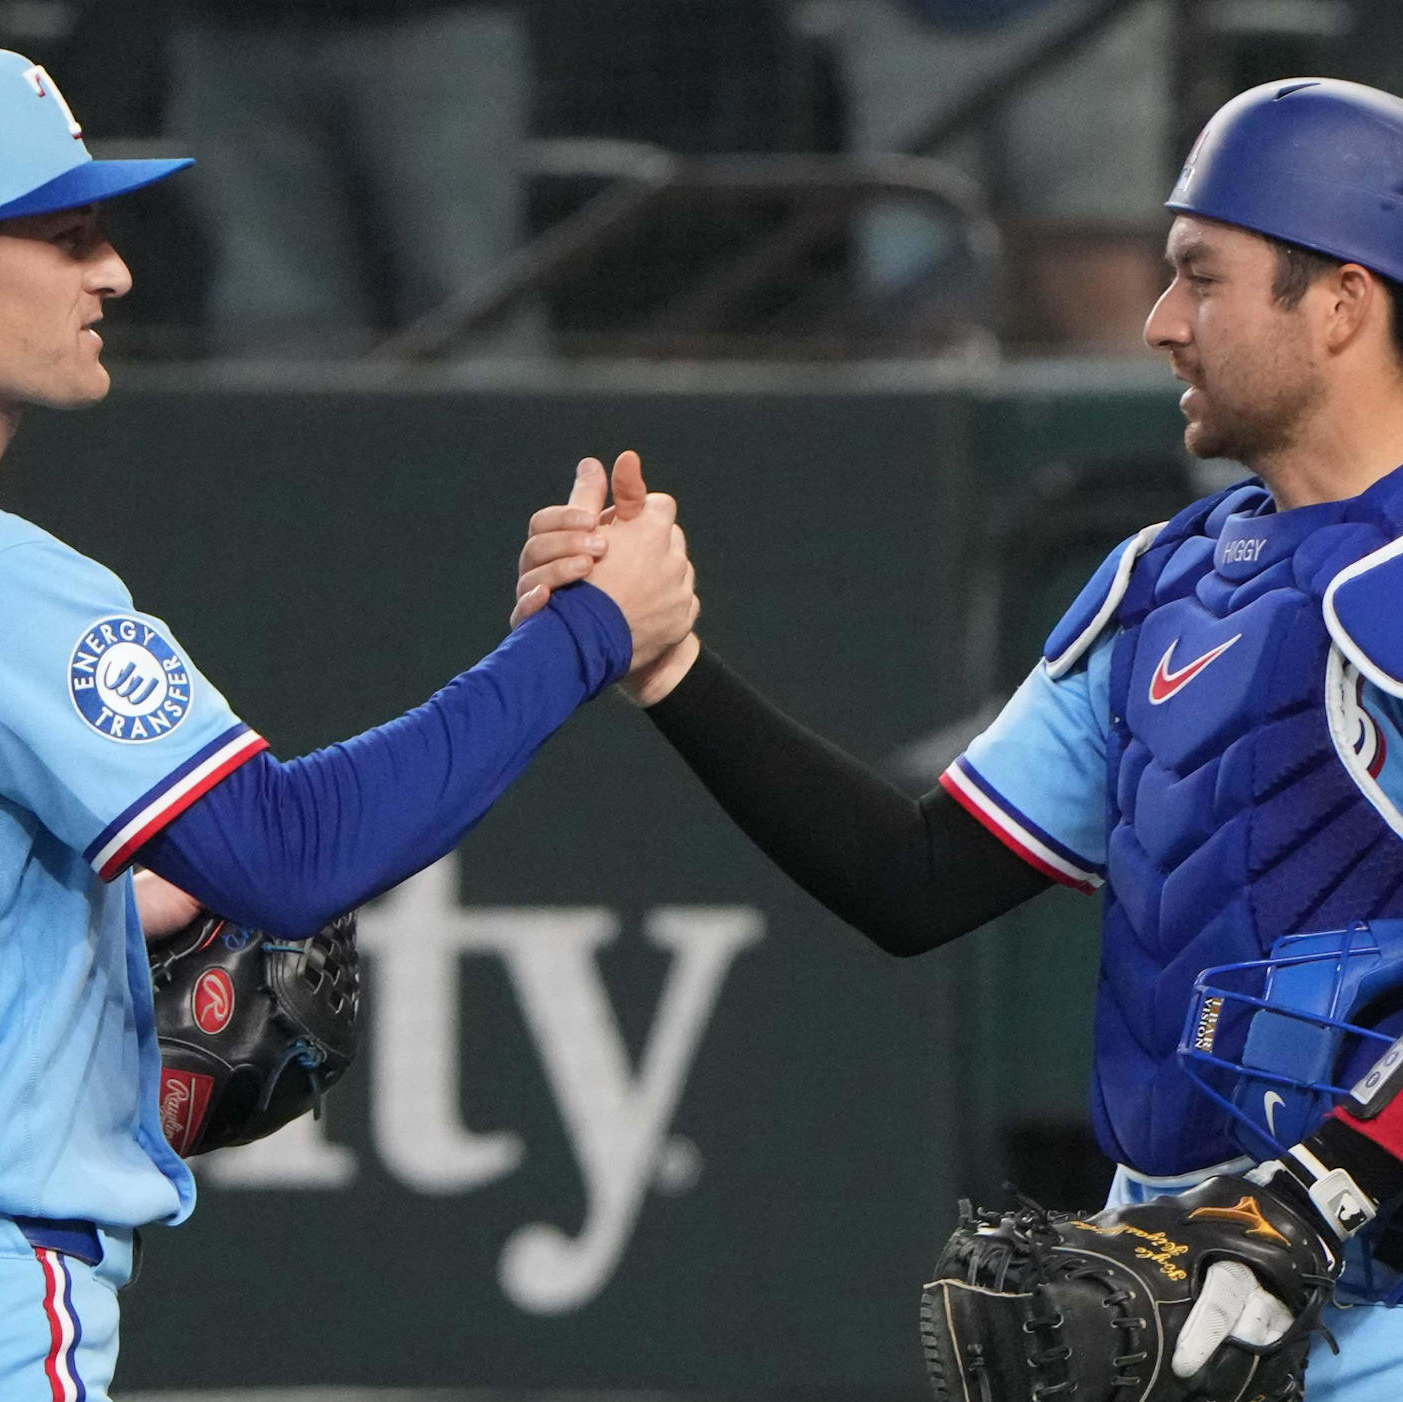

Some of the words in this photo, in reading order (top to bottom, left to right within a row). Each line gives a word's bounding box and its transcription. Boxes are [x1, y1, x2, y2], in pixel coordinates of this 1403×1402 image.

[1222, 539, 1268, 564] HIGGY
[72, 620, 156, 690] ENERGY
[95, 655, 189, 739] TRANSFER
[1195, 998, 1213, 1049] VISION
[194, 846, 768, 1316] ty
